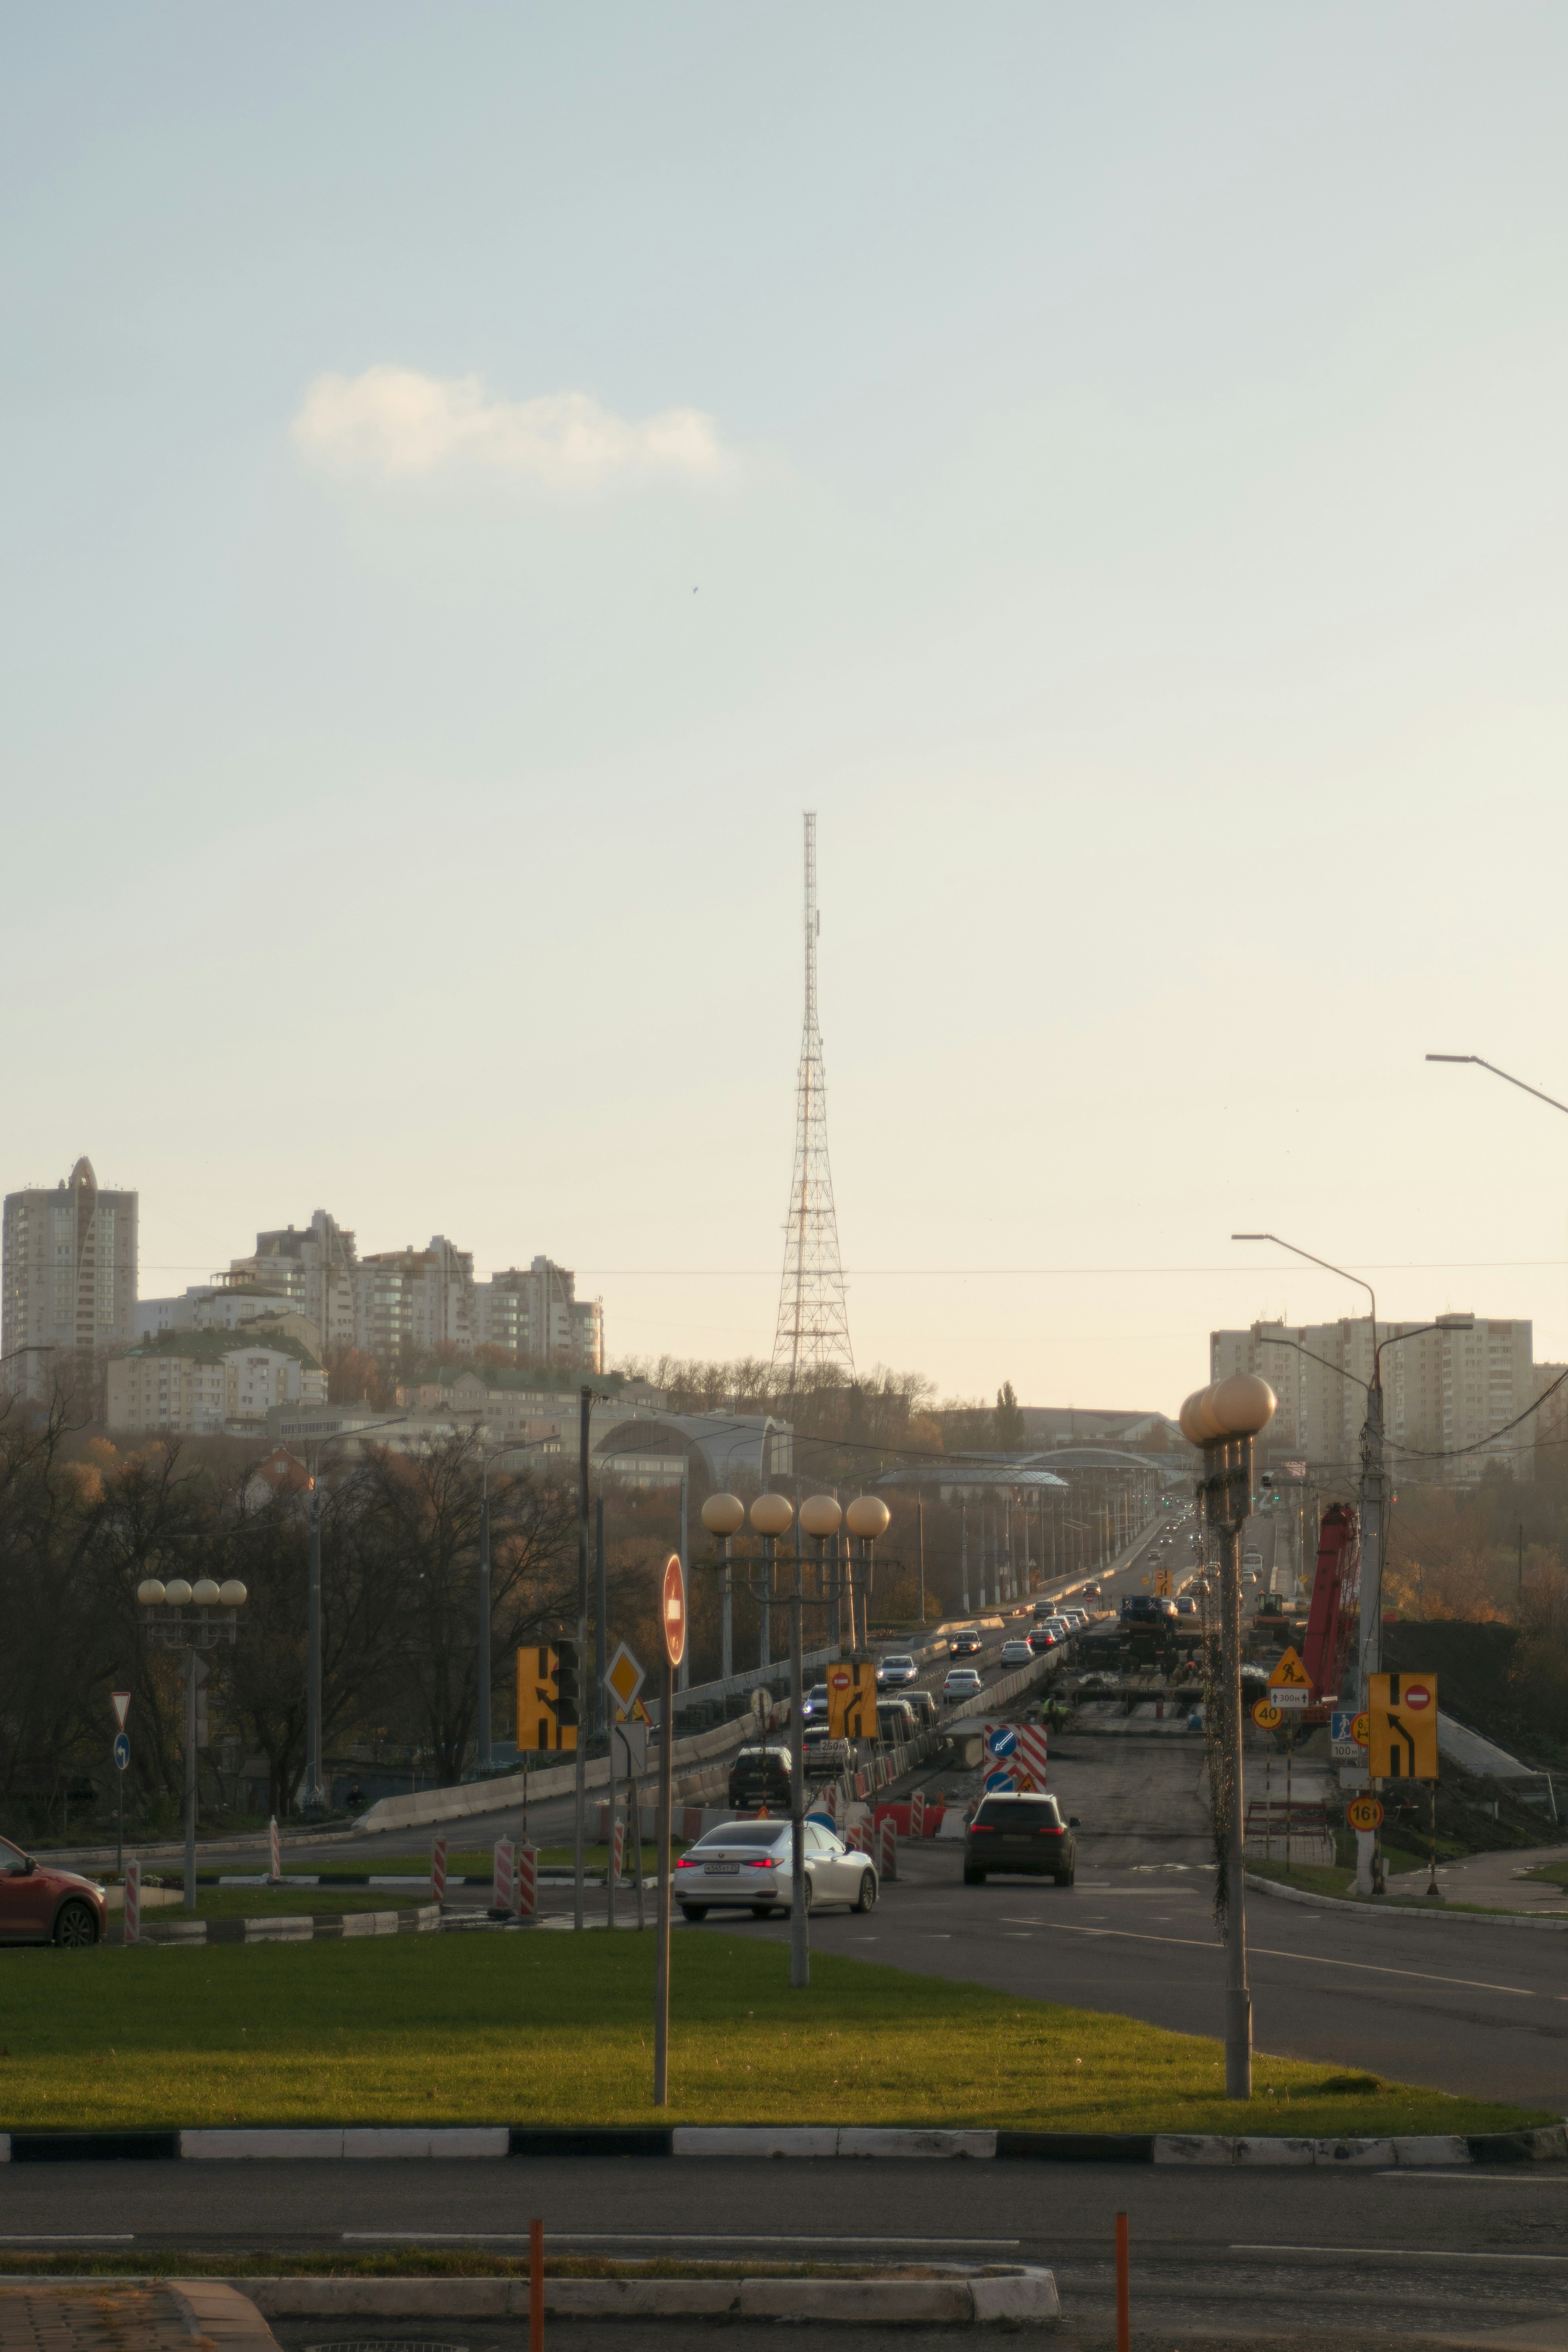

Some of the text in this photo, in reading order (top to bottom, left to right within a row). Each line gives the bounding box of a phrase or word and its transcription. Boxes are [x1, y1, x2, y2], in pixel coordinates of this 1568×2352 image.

[1259, 1707, 1277, 1720] 40
[1358, 1719, 1369, 1730] 6,
[1335, 1746, 1350, 1755] 100
